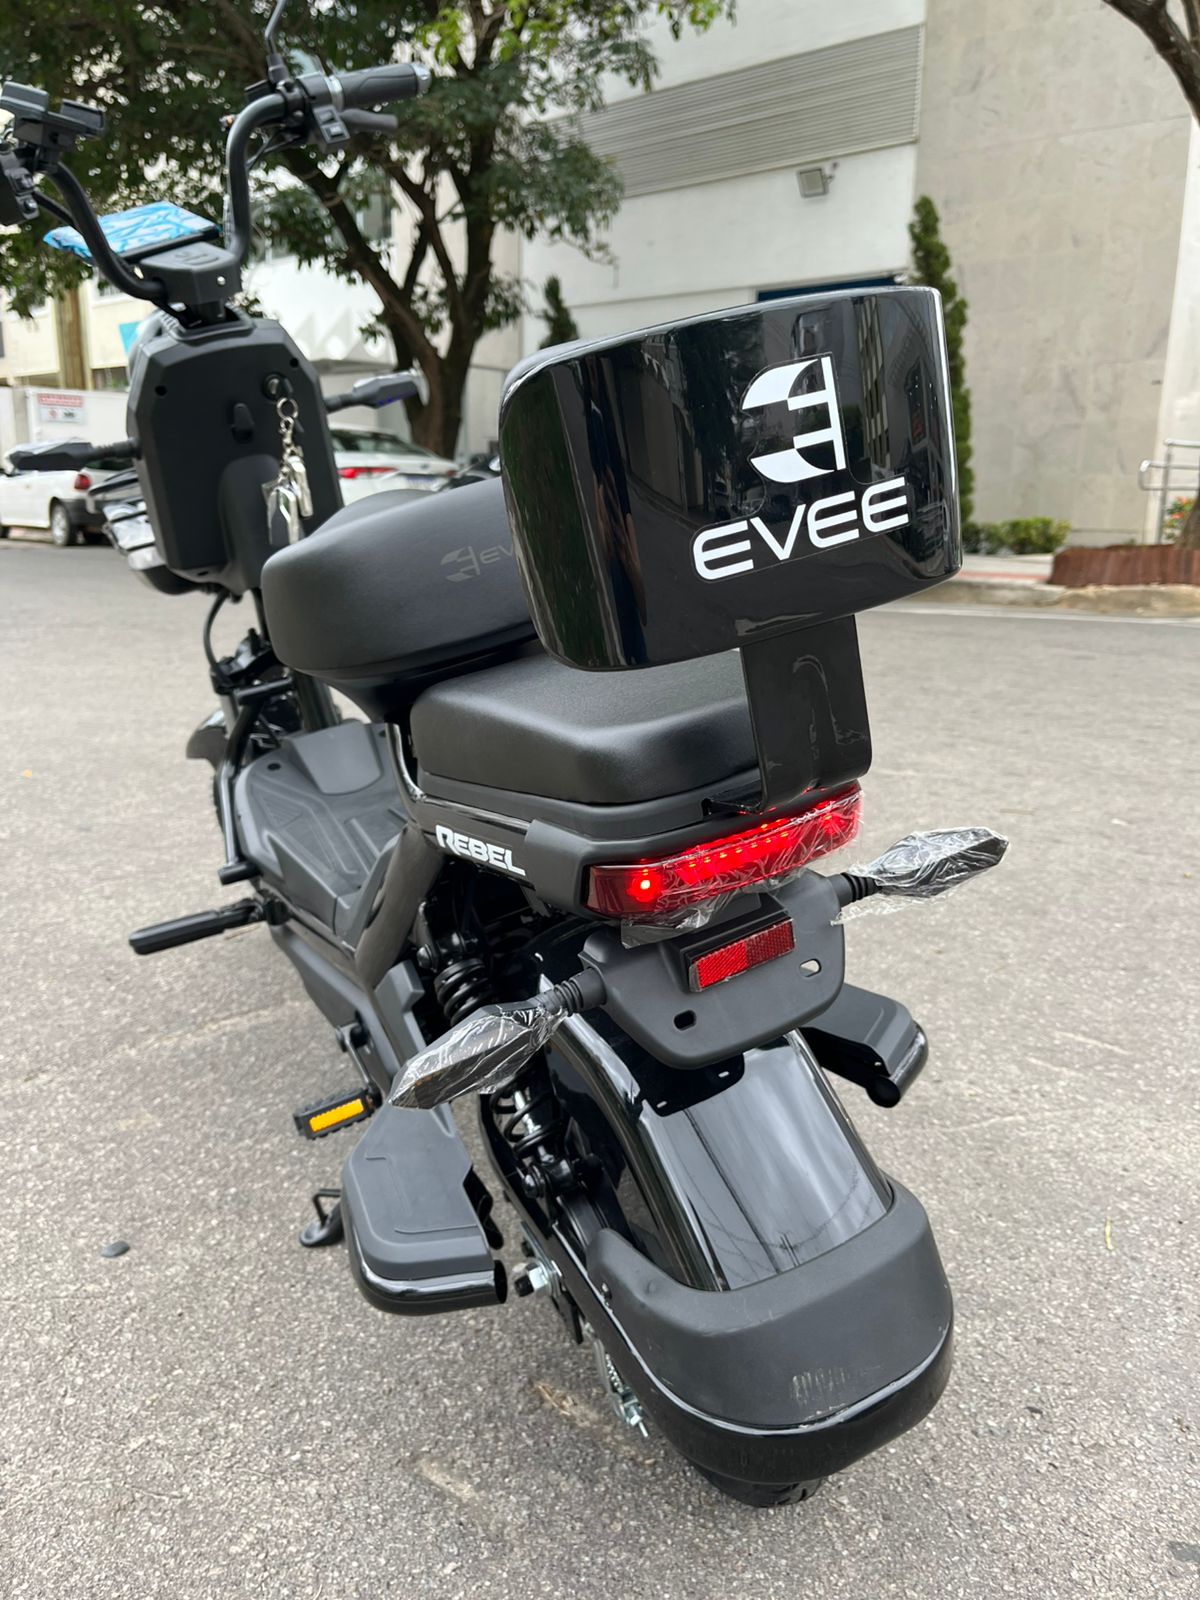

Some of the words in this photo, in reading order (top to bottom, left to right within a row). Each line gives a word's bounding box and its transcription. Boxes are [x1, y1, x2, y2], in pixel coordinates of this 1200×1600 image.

[692, 476, 909, 580] EVEE
[480, 545, 514, 564] EV
[435, 824, 526, 876] REBEL
